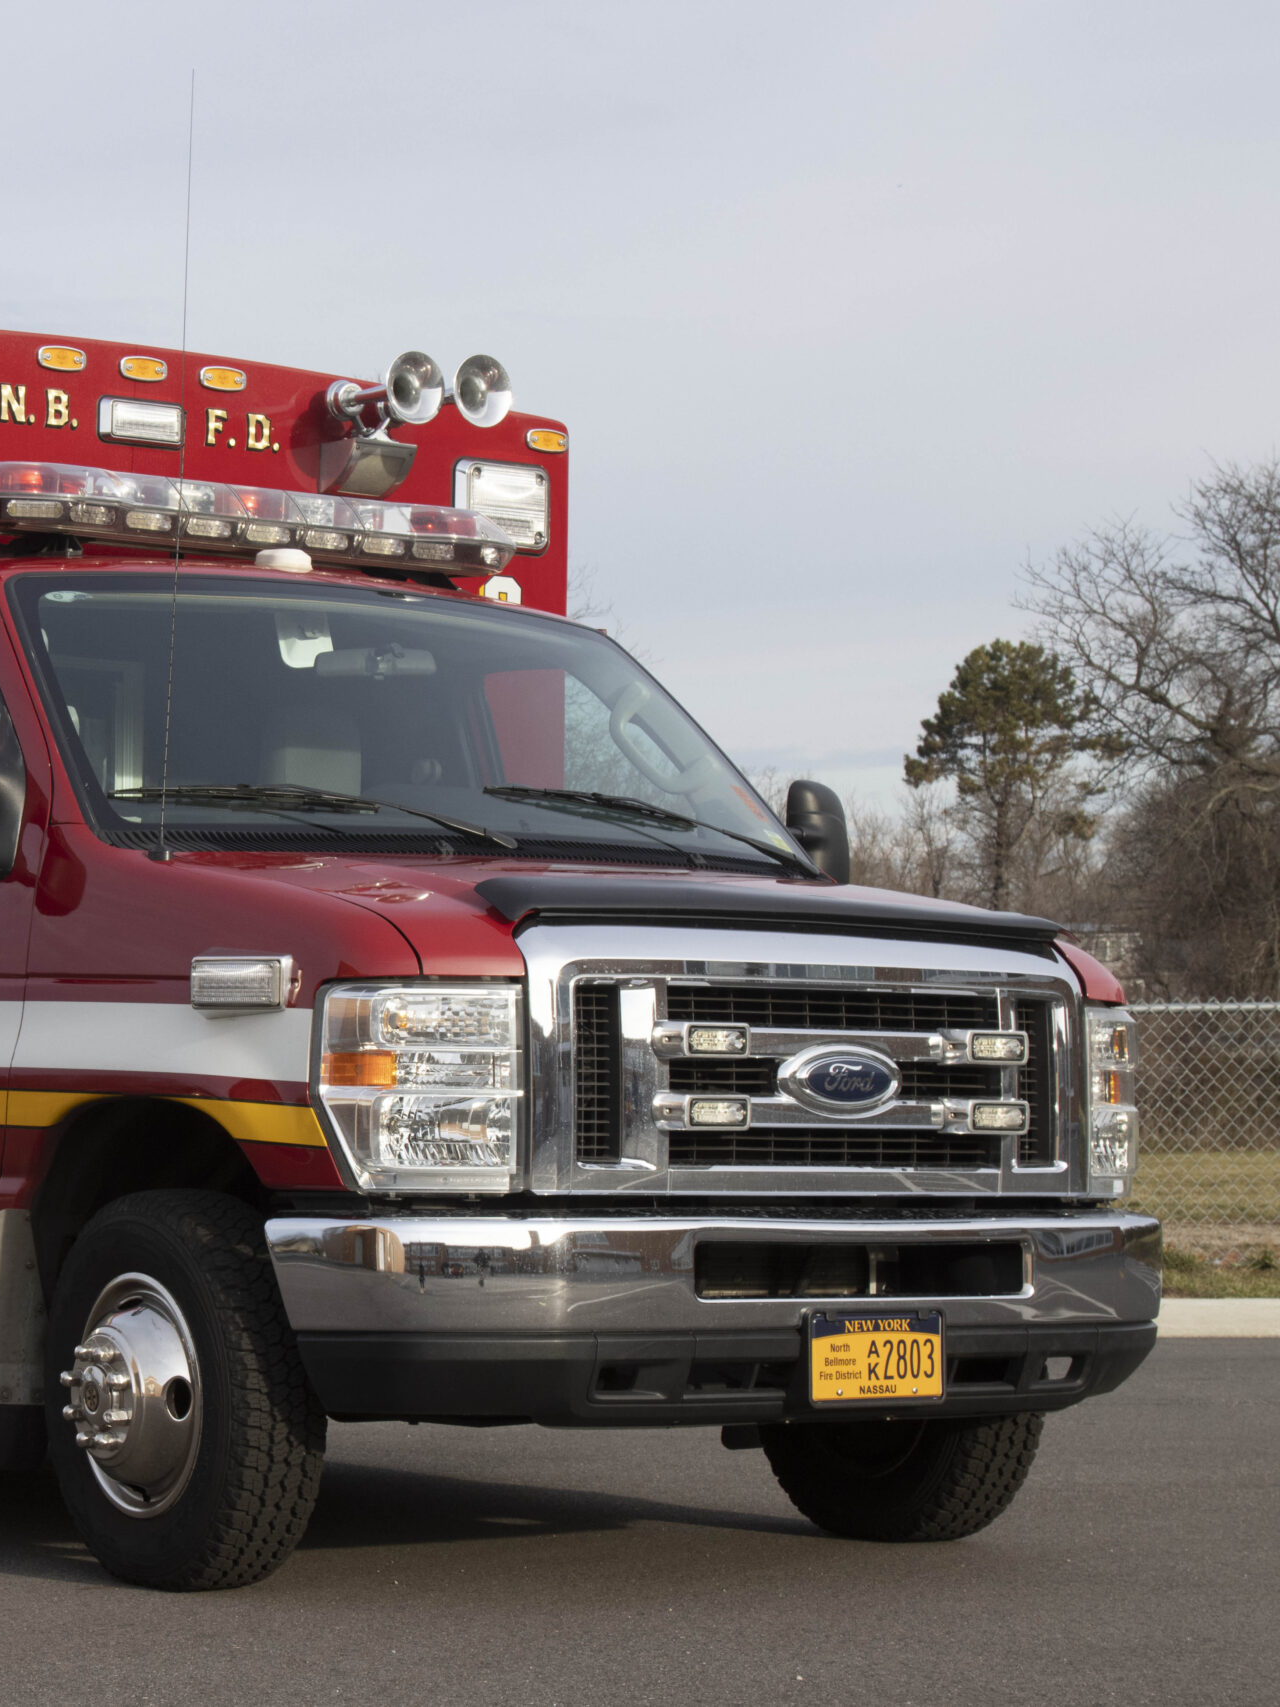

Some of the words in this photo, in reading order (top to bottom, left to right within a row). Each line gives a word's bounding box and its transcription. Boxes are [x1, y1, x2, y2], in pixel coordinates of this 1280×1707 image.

[824, 1063, 874, 1092] Ford
[844, 1319, 875, 1333] NEW
[877, 1318, 911, 1332] YORK
[830, 1343, 851, 1353] North
[824, 1357, 856, 1367] Bellmore
[819, 1371, 833, 1381] Fire
[835, 1370, 862, 1380] District
[859, 1384, 897, 1394] NASSAU
